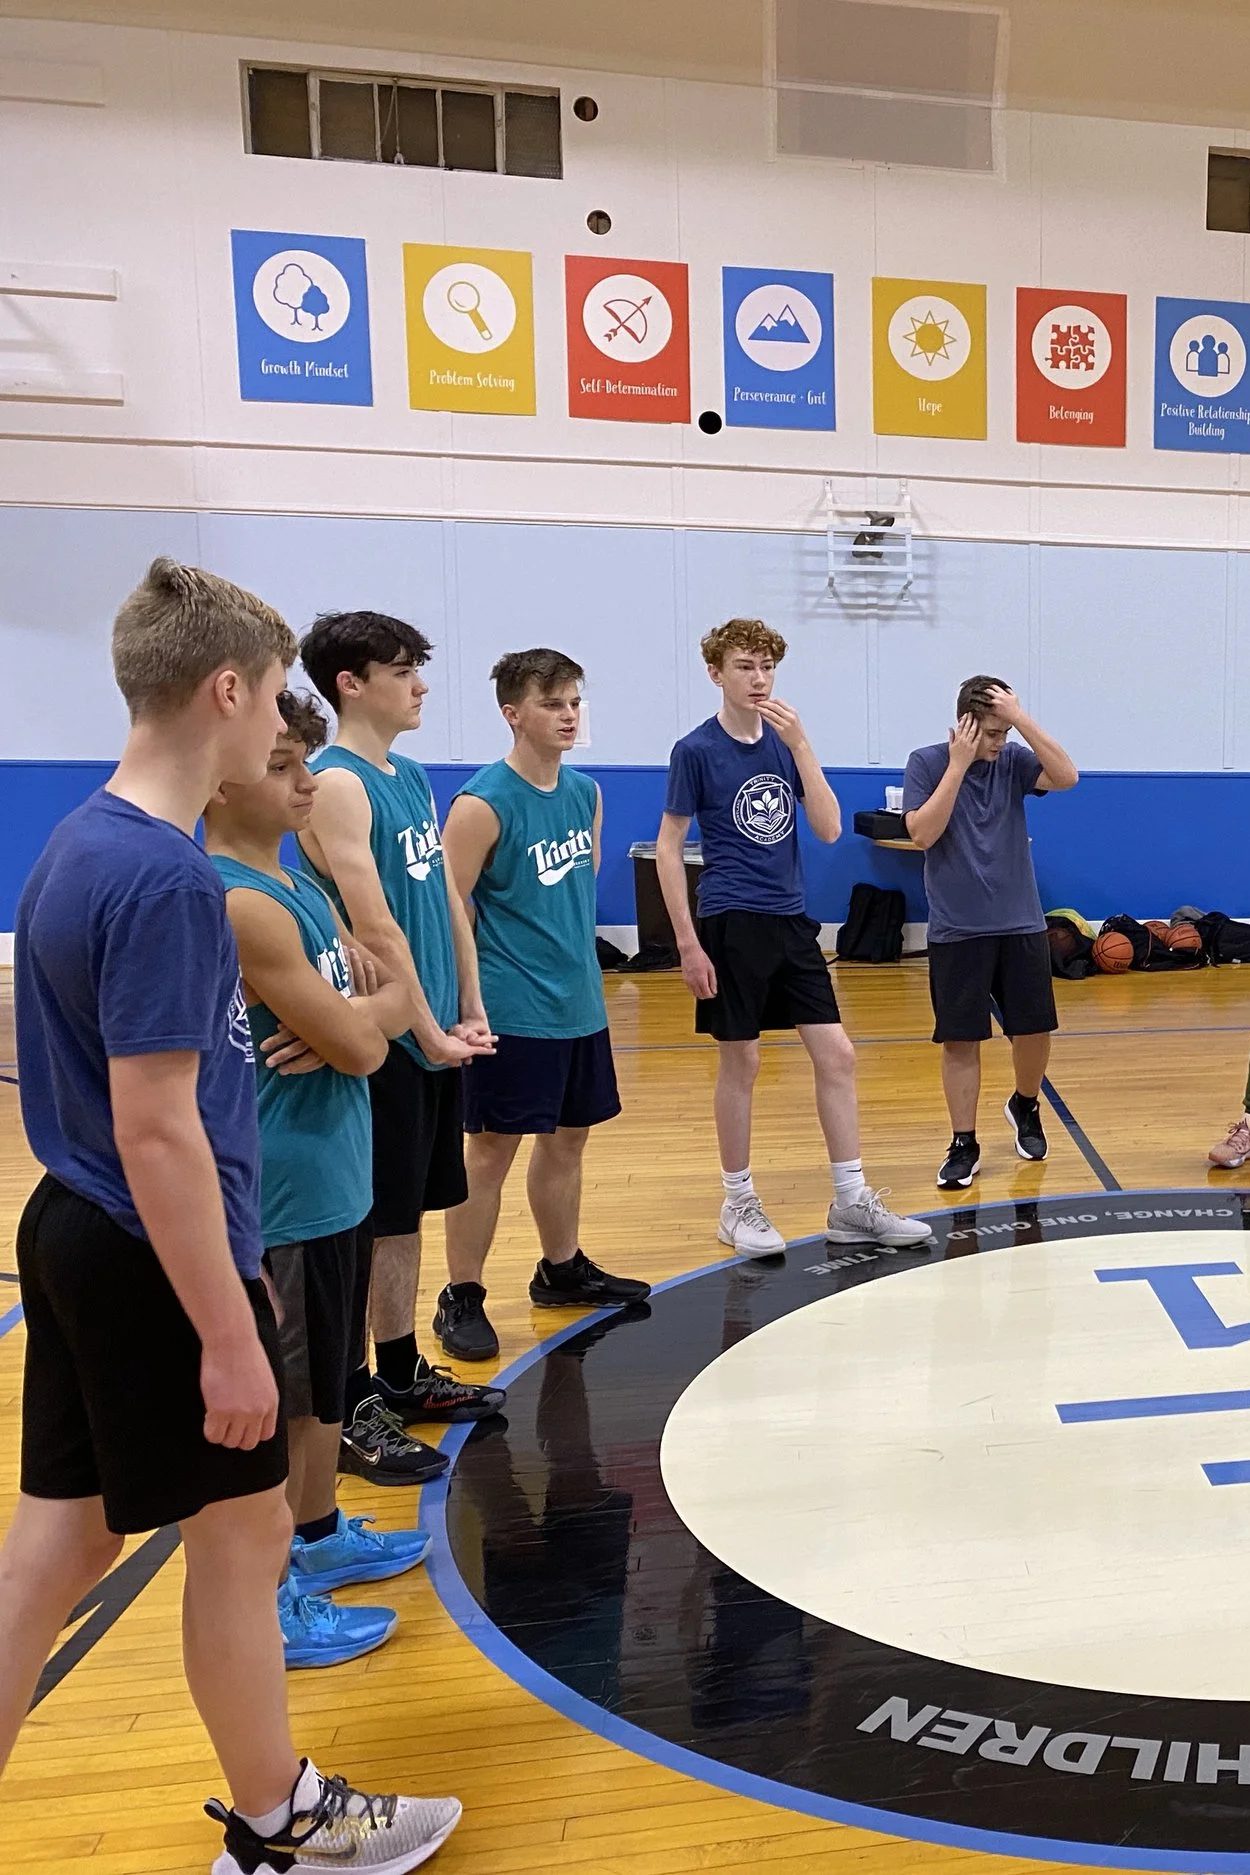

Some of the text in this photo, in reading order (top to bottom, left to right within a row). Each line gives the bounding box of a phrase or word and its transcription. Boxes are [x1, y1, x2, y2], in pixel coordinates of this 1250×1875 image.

[261, 358, 349, 378] Growth Mindset
[429, 369, 515, 392] Problem Solving
[580, 378, 677, 396] Self-Determination
[733, 386, 796, 404] Perseverance
[807, 390, 827, 405] Grit
[918, 397, 943, 416] Hope
[1049, 404, 1094, 425] Belonging
[1160, 402, 1196, 418] Positive
[1188, 421, 1226, 440] Building
[527, 827, 592, 886] Trinity
[1038, 1213, 1099, 1227] ONE
[1104, 1208, 1234, 1221] CHANGE,
[946, 1221, 1032, 1240] CHILD
[803, 1252, 879, 1275] TIME
